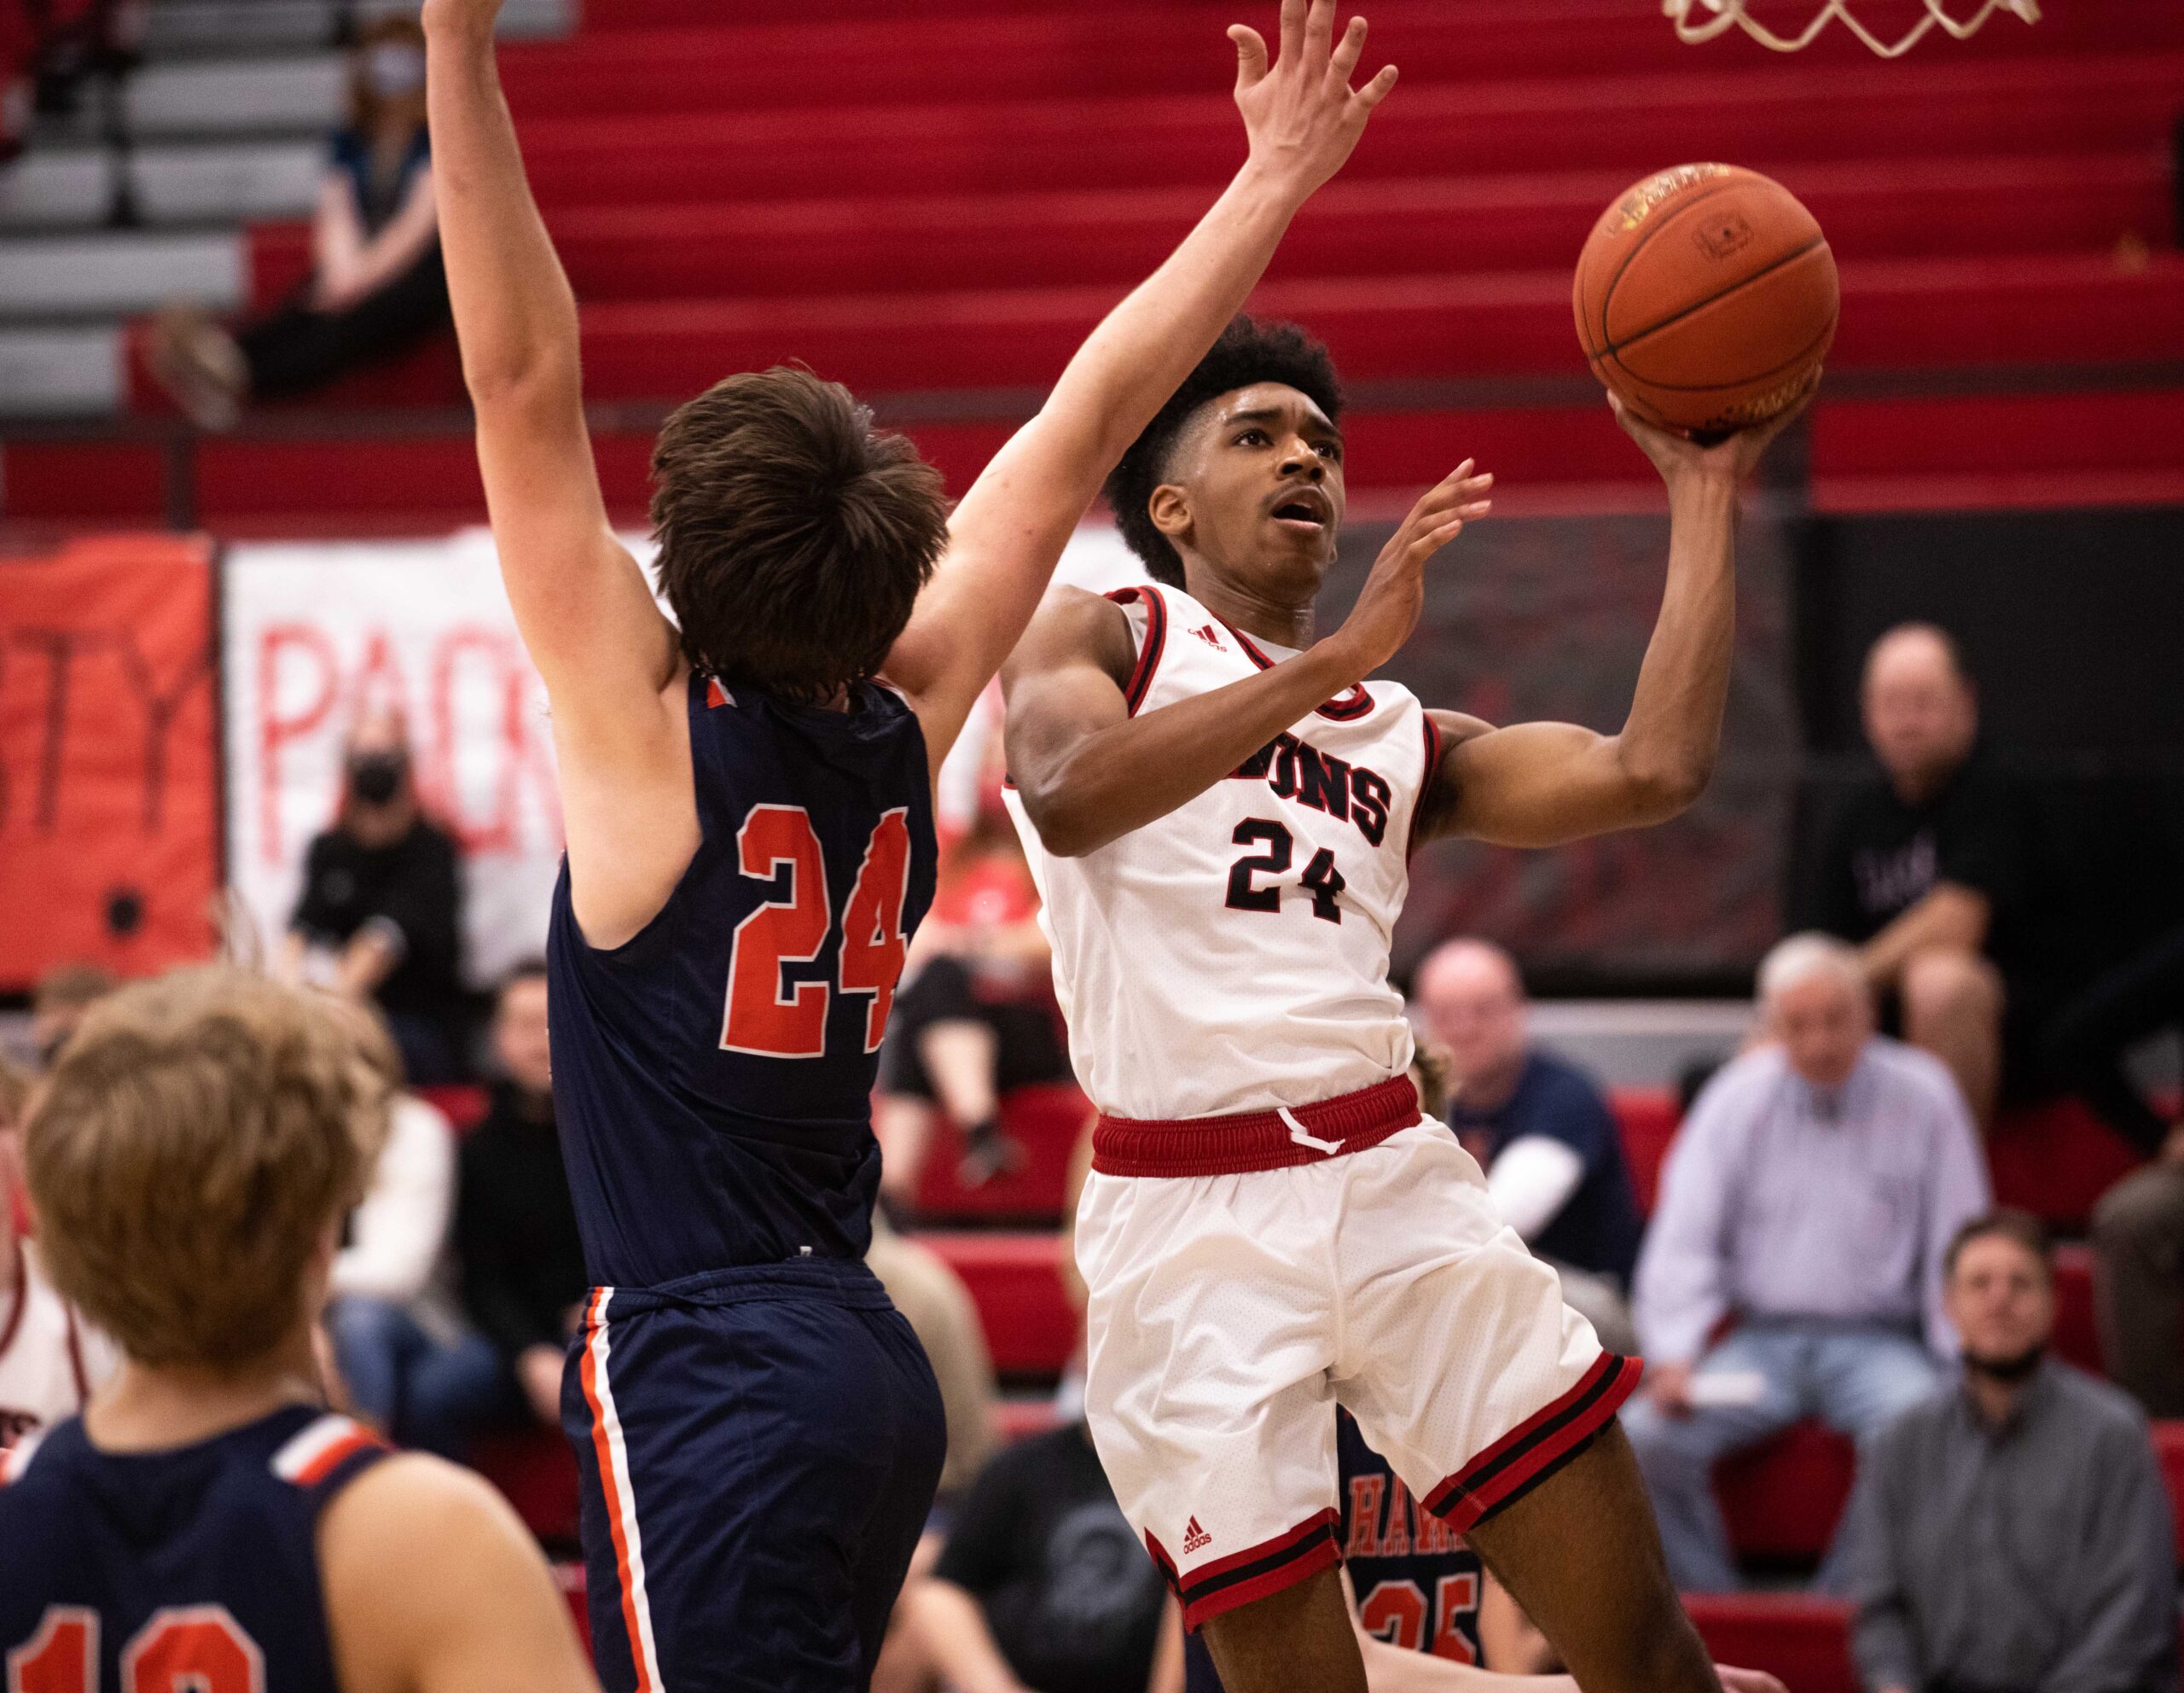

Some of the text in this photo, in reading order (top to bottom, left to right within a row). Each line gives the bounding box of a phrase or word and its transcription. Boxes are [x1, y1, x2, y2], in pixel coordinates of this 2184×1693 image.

[0, 626, 215, 838] TY
[1225, 731, 1392, 847] ONS
[1224, 817, 1346, 926] 24
[718, 803, 911, 1060] 24
[1183, 1533, 1212, 1555] adidas
